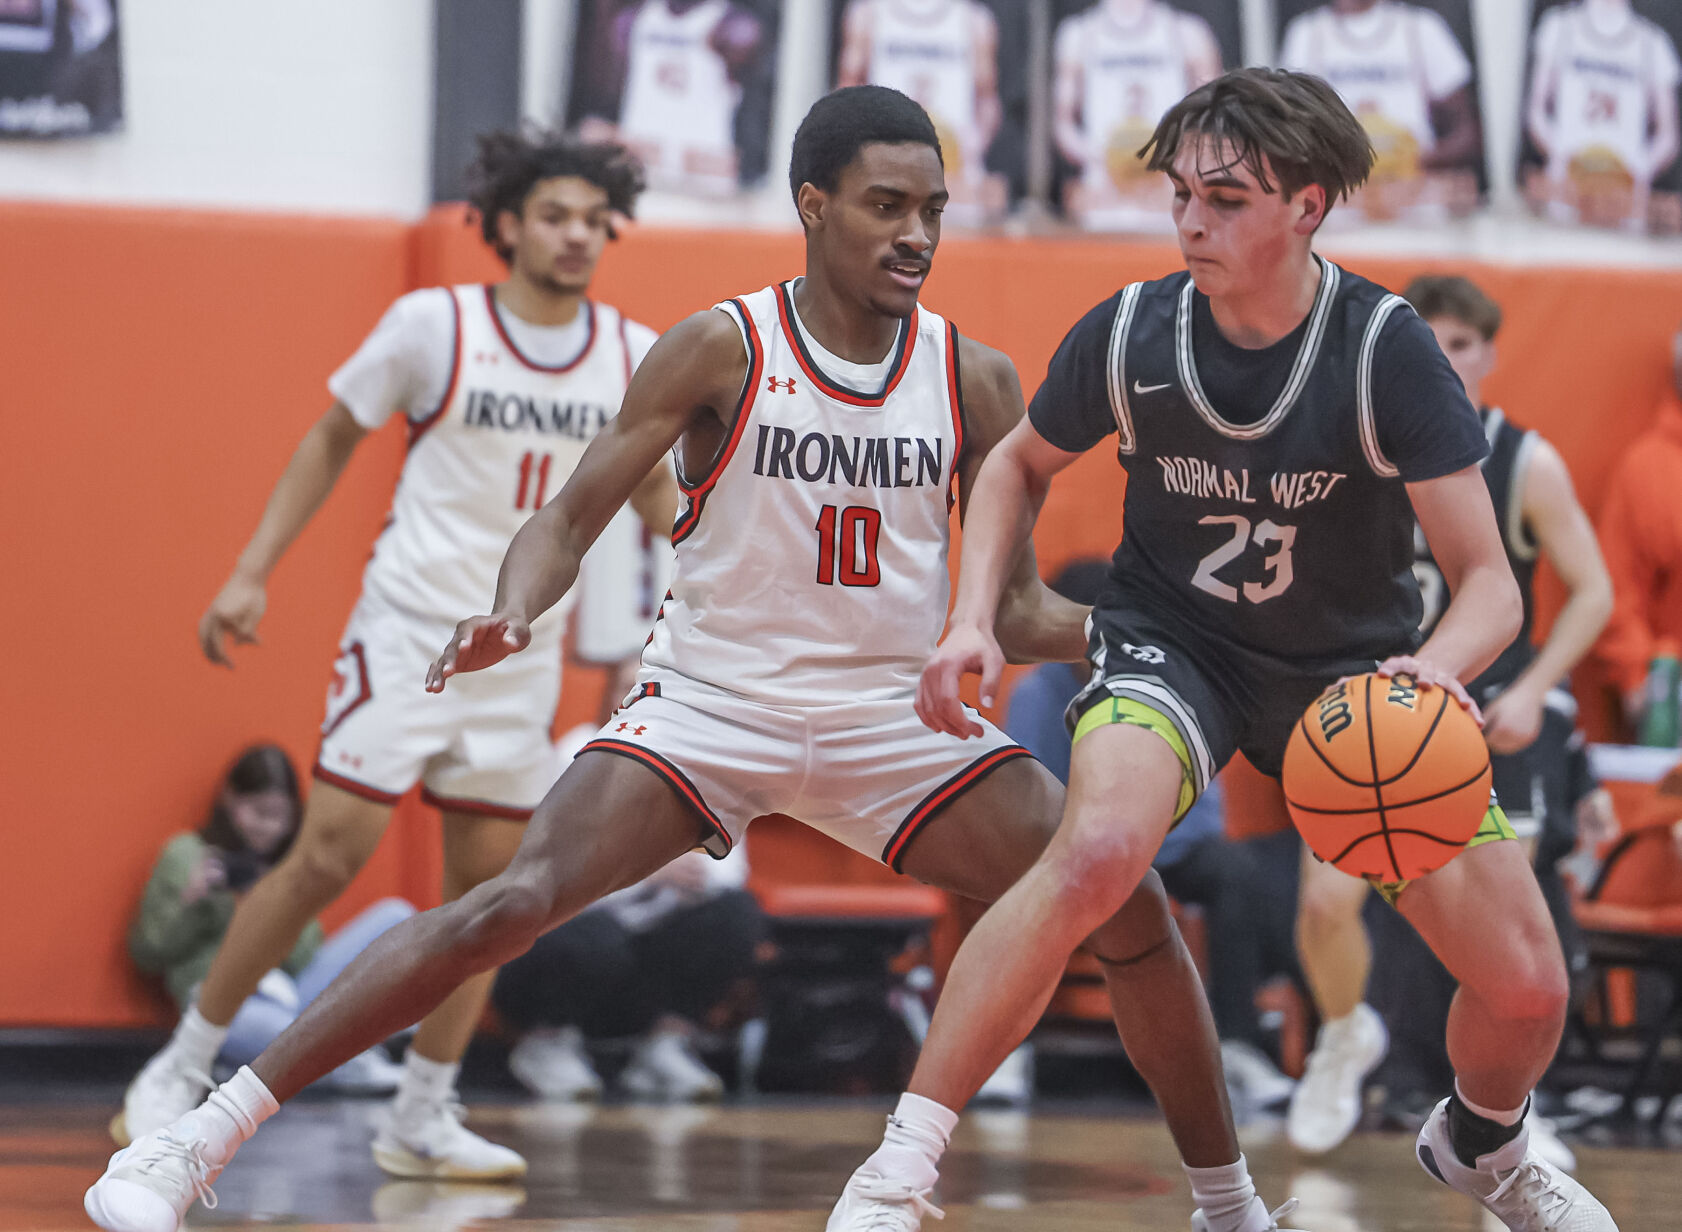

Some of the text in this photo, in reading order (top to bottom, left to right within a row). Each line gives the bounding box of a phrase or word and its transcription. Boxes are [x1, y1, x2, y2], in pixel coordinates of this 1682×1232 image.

[515, 451, 552, 511] 11
[753, 424, 943, 488] IRONMEN
[1156, 456, 1347, 509] NORMAL WEST
[815, 504, 882, 588] 10
[1190, 514, 1298, 605] 23
[1317, 682, 1353, 743] Wil
